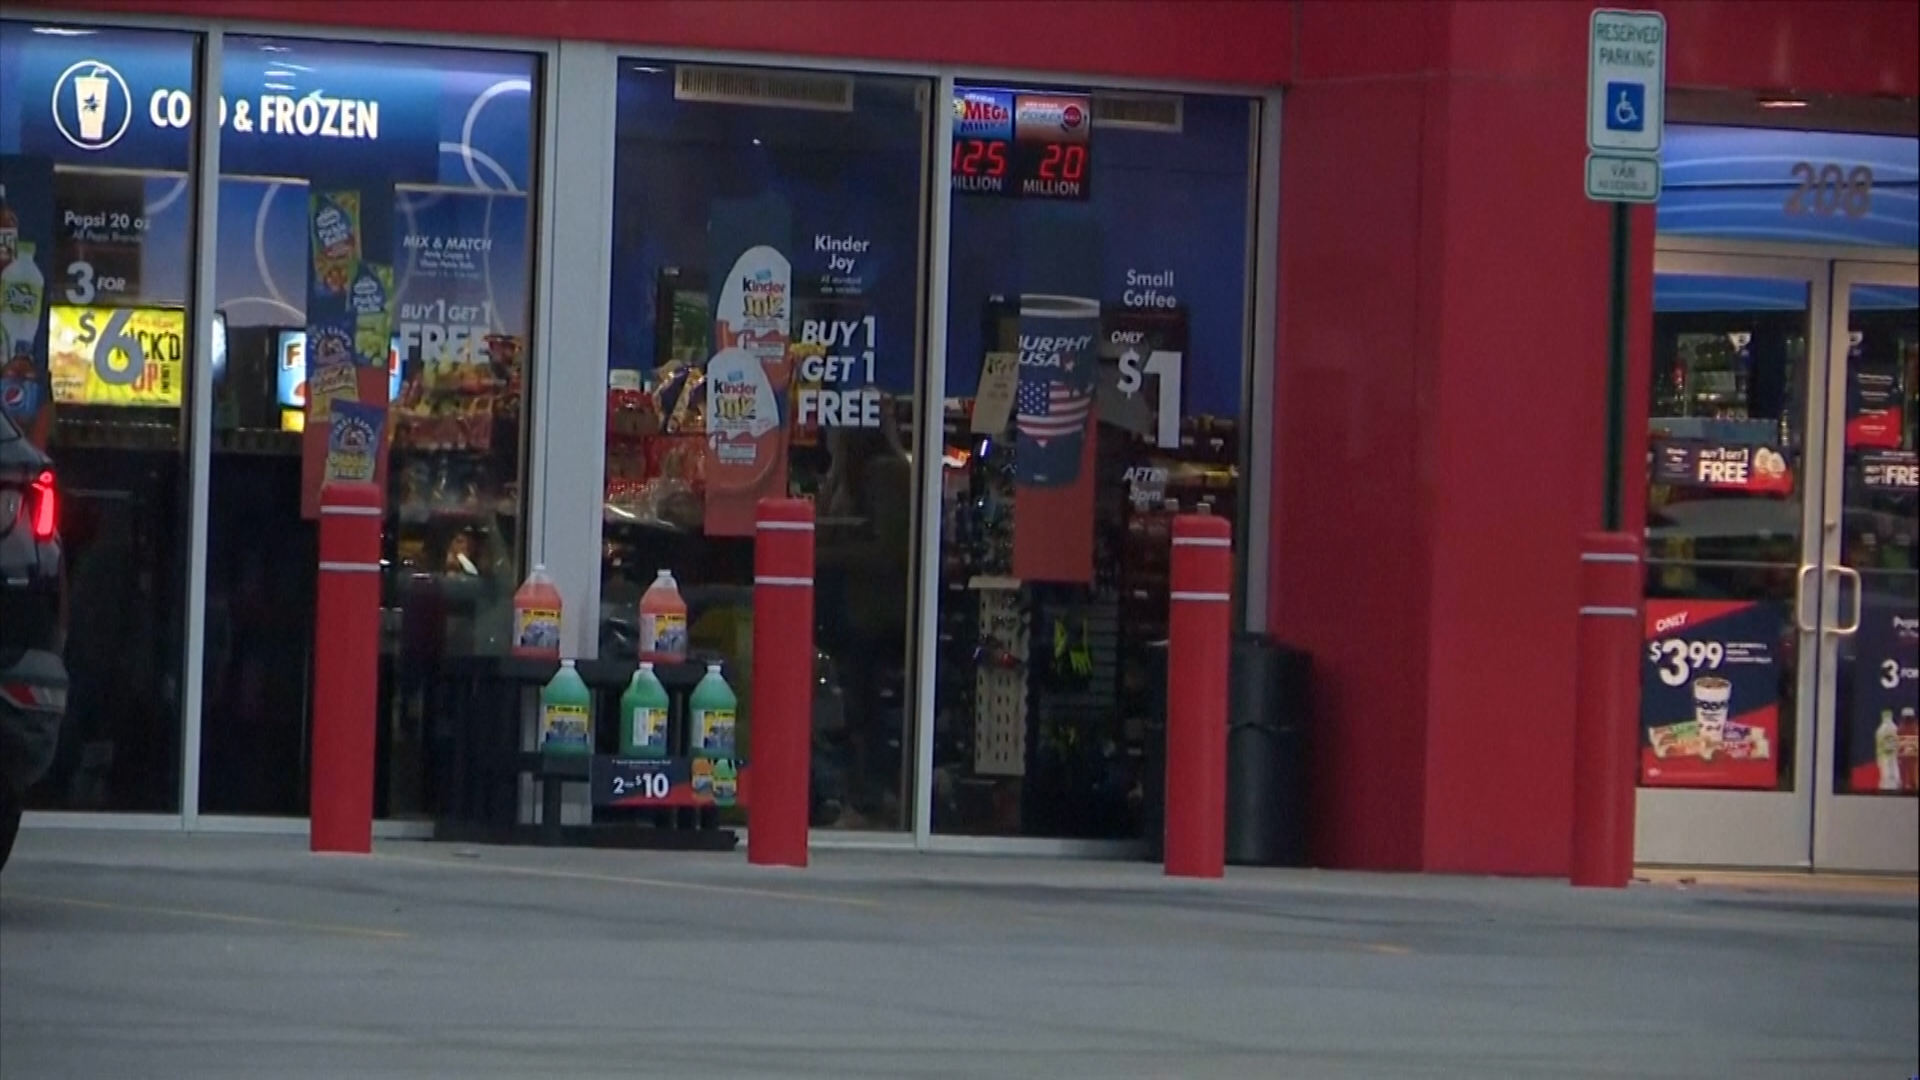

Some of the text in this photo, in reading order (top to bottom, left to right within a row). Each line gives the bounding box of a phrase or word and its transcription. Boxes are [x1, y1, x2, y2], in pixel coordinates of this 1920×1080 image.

[1597, 22, 1660, 44] RESERVED
[1600, 47, 1655, 68] PARKING
[233, 99, 253, 132] &
[260, 95, 378, 139] FROZEN
[964, 99, 1009, 120] MEGA
[1039, 143, 1086, 180] 20
[1611, 163, 1637, 179] VAN
[1023, 179, 1080, 196] MILLION
[1783, 162, 1873, 218] 208
[64, 210, 105, 229] Pepsi
[110, 213, 130, 228] 20
[403, 235, 430, 248] MIX
[445, 237, 492, 251] MATCH
[814, 235, 871, 252] Kinder
[828, 253, 855, 273] Joy
[65, 261, 95, 304] 3
[97, 278, 126, 291] FOR
[1127, 269, 1174, 287] Small
[1123, 289, 1177, 309] Coffee
[401, 303, 434, 319] BUY
[435, 299, 445, 324] 1
[448, 305, 479, 321] GET
[802, 315, 876, 348] BUY 1
[1111, 331, 1144, 344] ONLY
[400, 322, 491, 364] FREE
[801, 351, 876, 383] GET 1
[1018, 350, 1061, 368] USA
[799, 389, 881, 427] FREE
[1117, 347, 1183, 449] $1
[1699, 461, 1748, 483] FREE
[1656, 612, 1687, 632] ONLY
[1880, 659, 1900, 688] 3
[613, 777, 625, 795] 2
